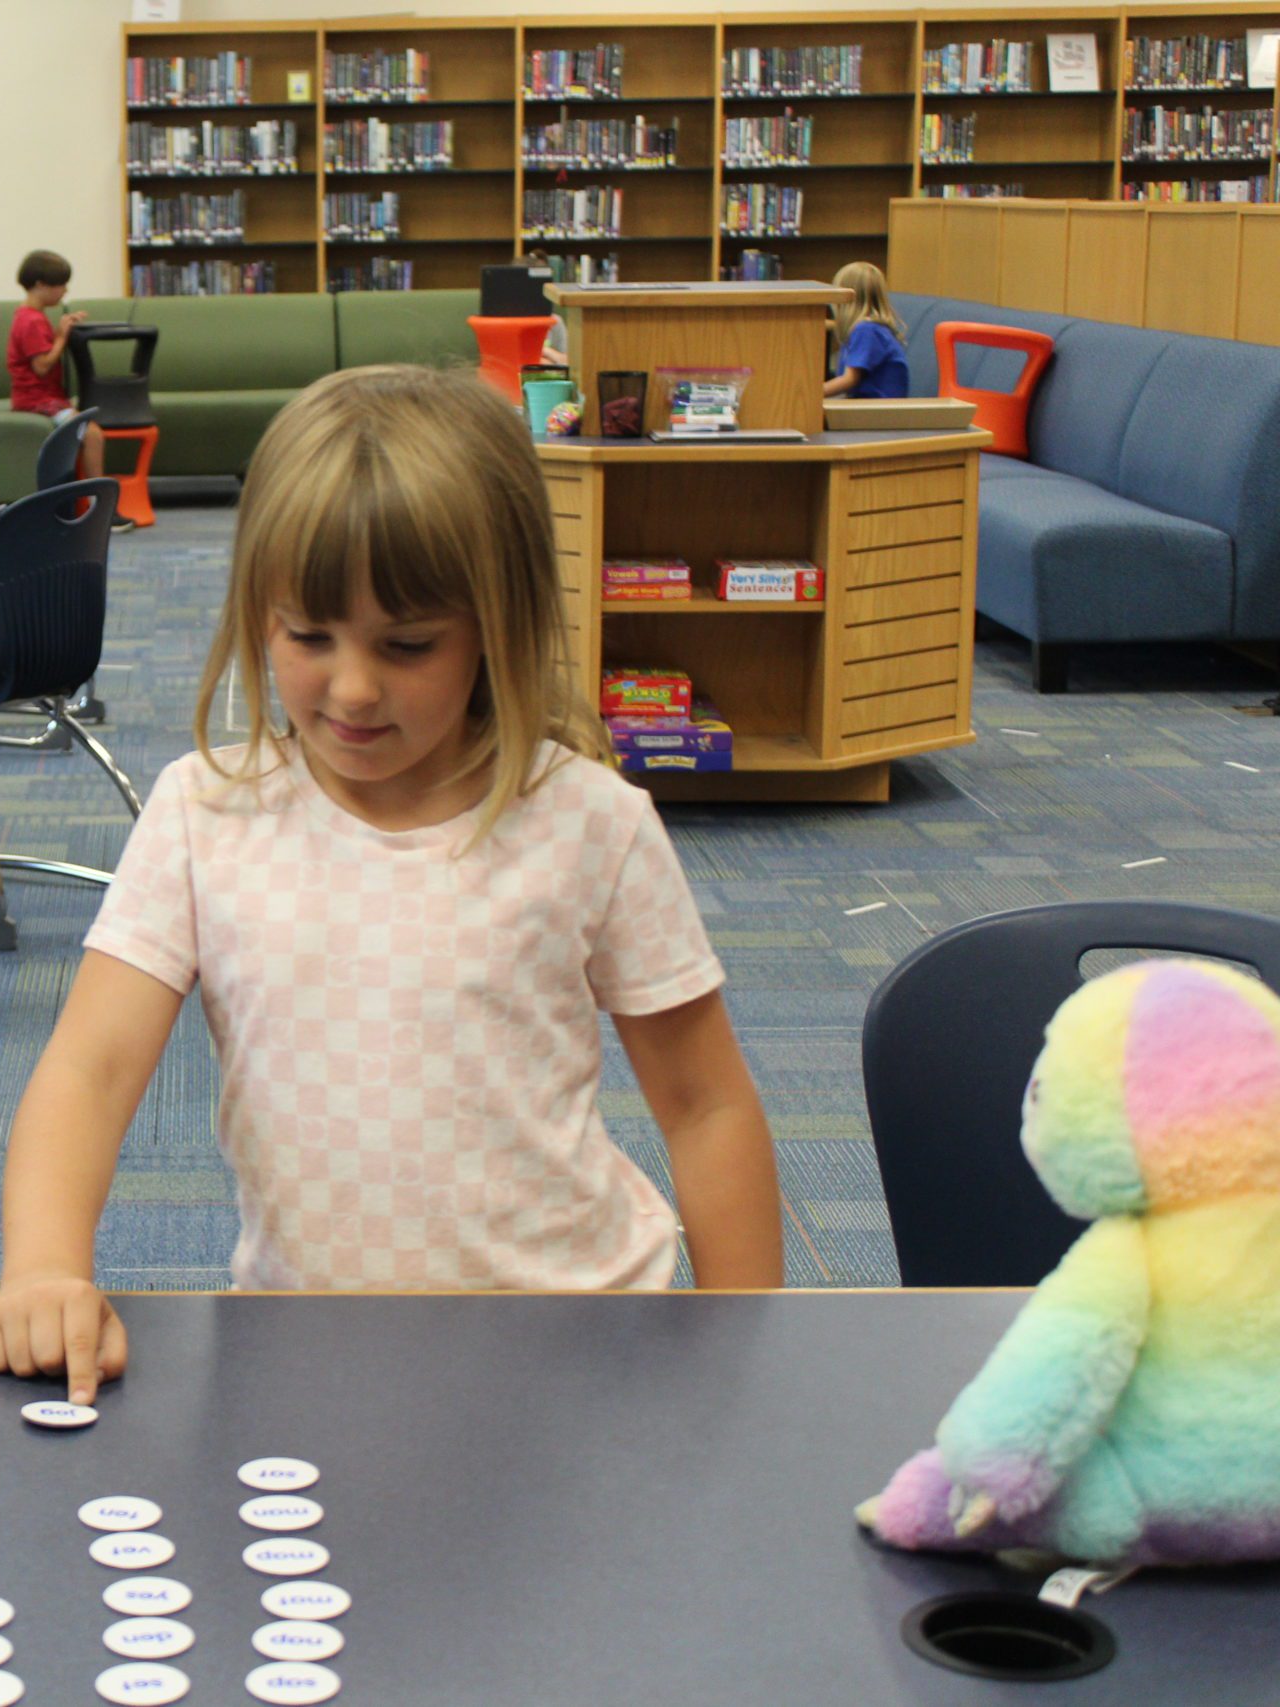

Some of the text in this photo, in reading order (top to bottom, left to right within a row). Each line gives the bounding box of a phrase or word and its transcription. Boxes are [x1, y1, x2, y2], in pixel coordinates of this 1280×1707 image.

[729, 585, 793, 593] Sentences
[125, 1590, 169, 1601] yes
[270, 1634, 323, 1646] nap
